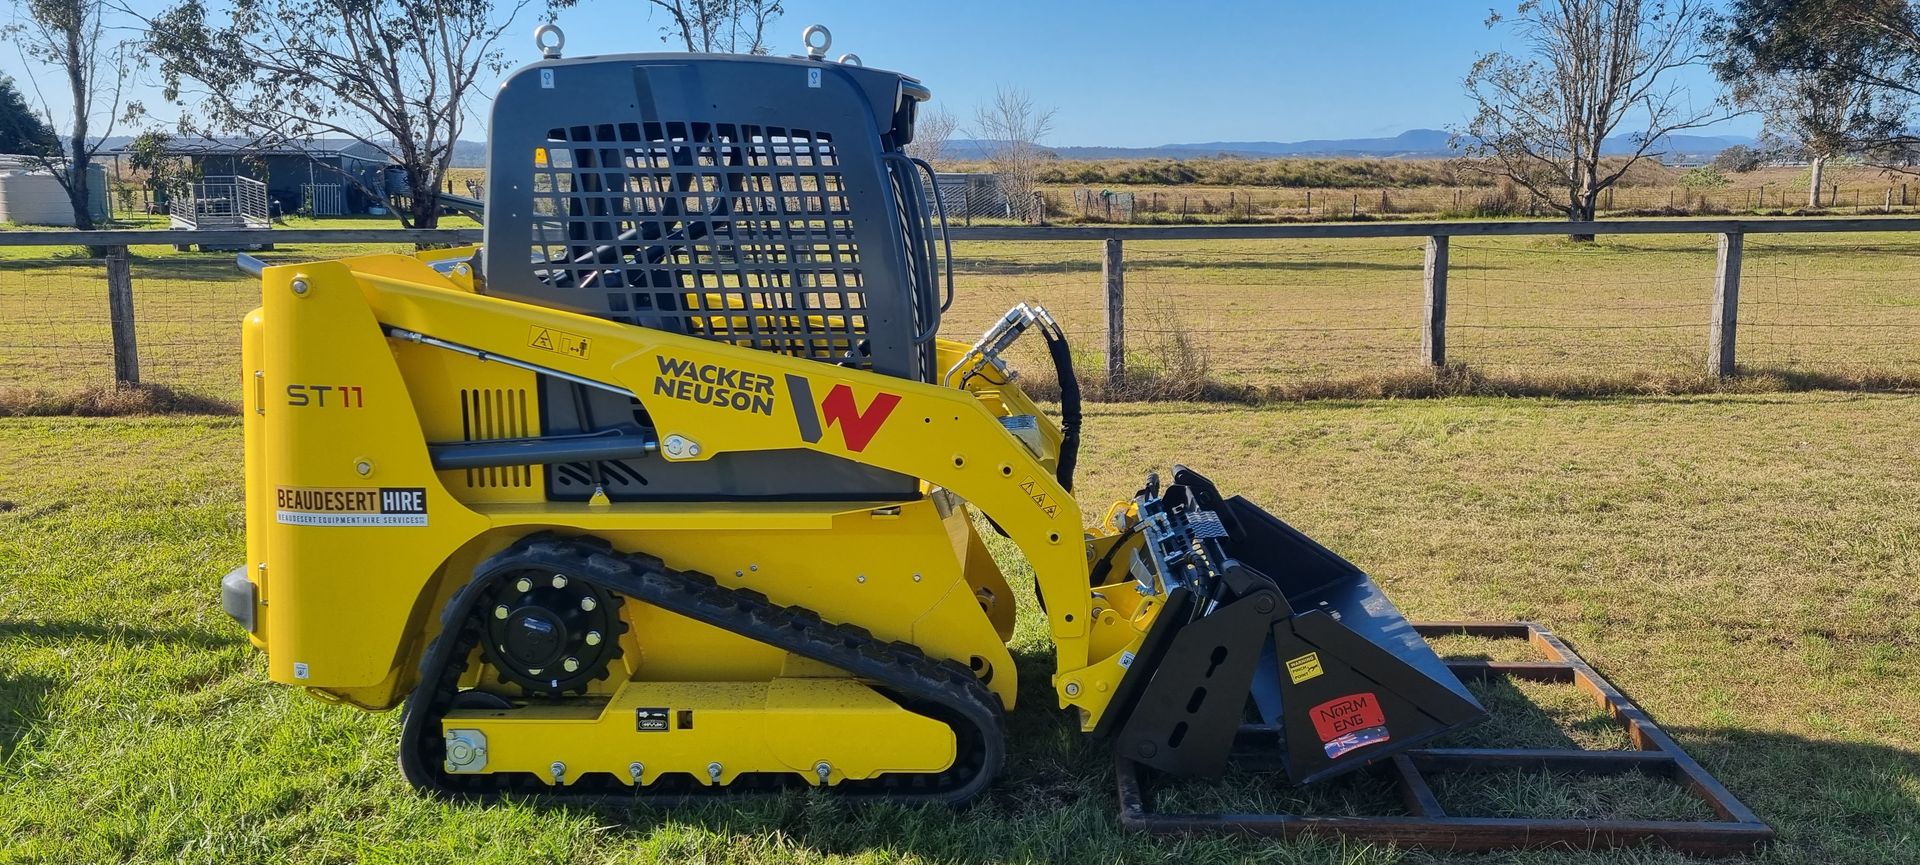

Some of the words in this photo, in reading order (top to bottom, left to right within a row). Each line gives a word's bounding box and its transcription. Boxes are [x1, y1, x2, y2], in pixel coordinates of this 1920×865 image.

[656, 355, 775, 396] WACKER
[653, 376, 774, 416] NEUSON
[277, 488, 377, 511] BEAUDESERT
[383, 491, 424, 511] HIRE
[278, 513, 316, 523] BEAUDESERT
[318, 516, 361, 524] EQUIPMENT
[1290, 656, 1314, 667] WARNING
[1320, 697, 1367, 722] NORM
[1334, 714, 1363, 732] ENG
